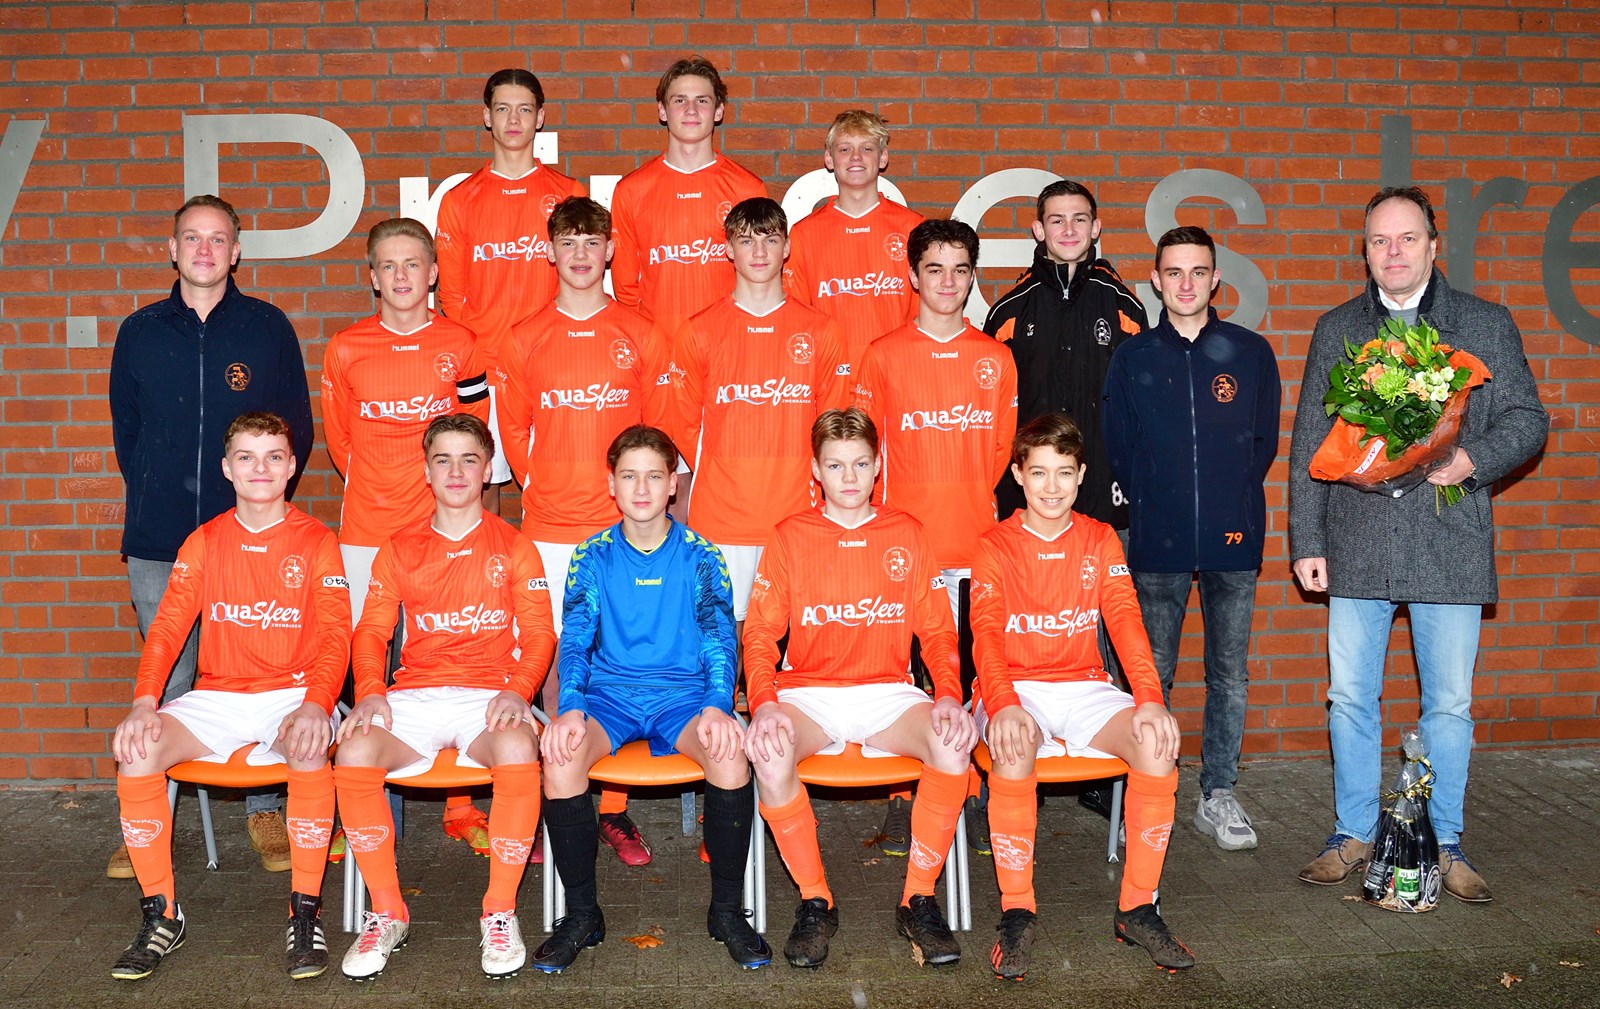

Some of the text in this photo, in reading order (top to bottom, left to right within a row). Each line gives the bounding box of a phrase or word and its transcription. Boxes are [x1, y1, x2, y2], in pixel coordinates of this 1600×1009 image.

[846, 226, 871, 234] hummel
[392, 344, 419, 352] hummel
[932, 351, 958, 359] hummel
[1111, 481, 1130, 506] 8
[1224, 532, 1243, 545] 79
[838, 539, 867, 548] hummel
[242, 544, 267, 553] hummel
[1038, 552, 1065, 560] hummel
[636, 577, 662, 586] hummel
